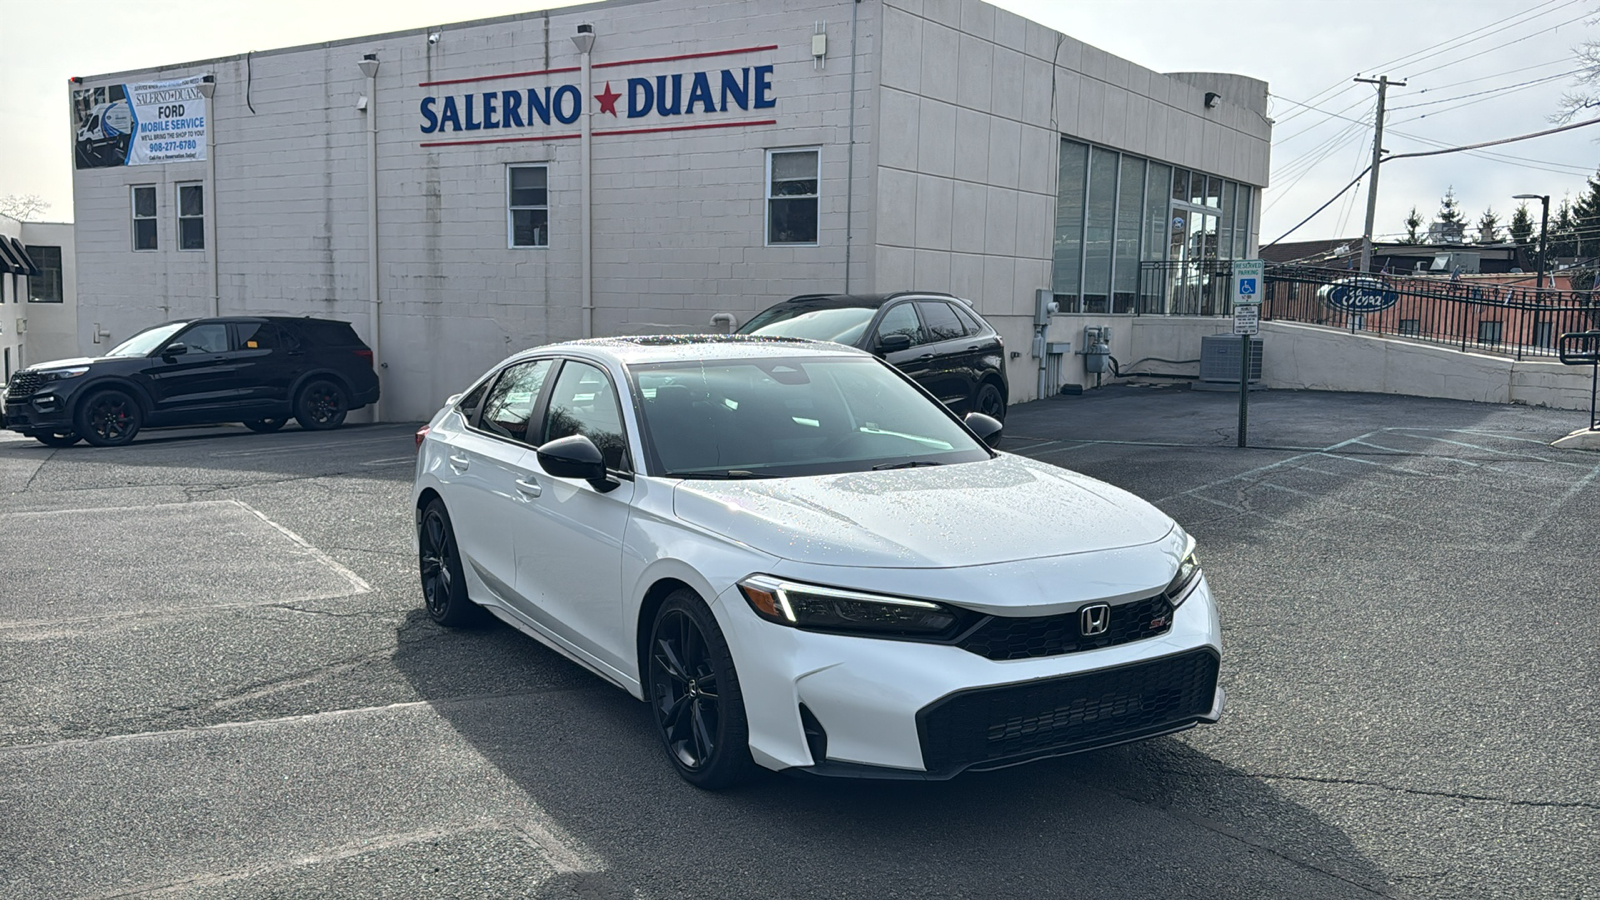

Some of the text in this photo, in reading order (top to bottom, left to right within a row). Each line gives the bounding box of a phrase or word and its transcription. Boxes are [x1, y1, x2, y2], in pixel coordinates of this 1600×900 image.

[136, 90, 171, 105] SALERNO
[420, 65, 778, 133] SALERNO DUANE
[158, 104, 185, 119] FORD
[140, 116, 204, 133] MOBILE SERVICE
[149, 139, 197, 153] 908-277-6780
